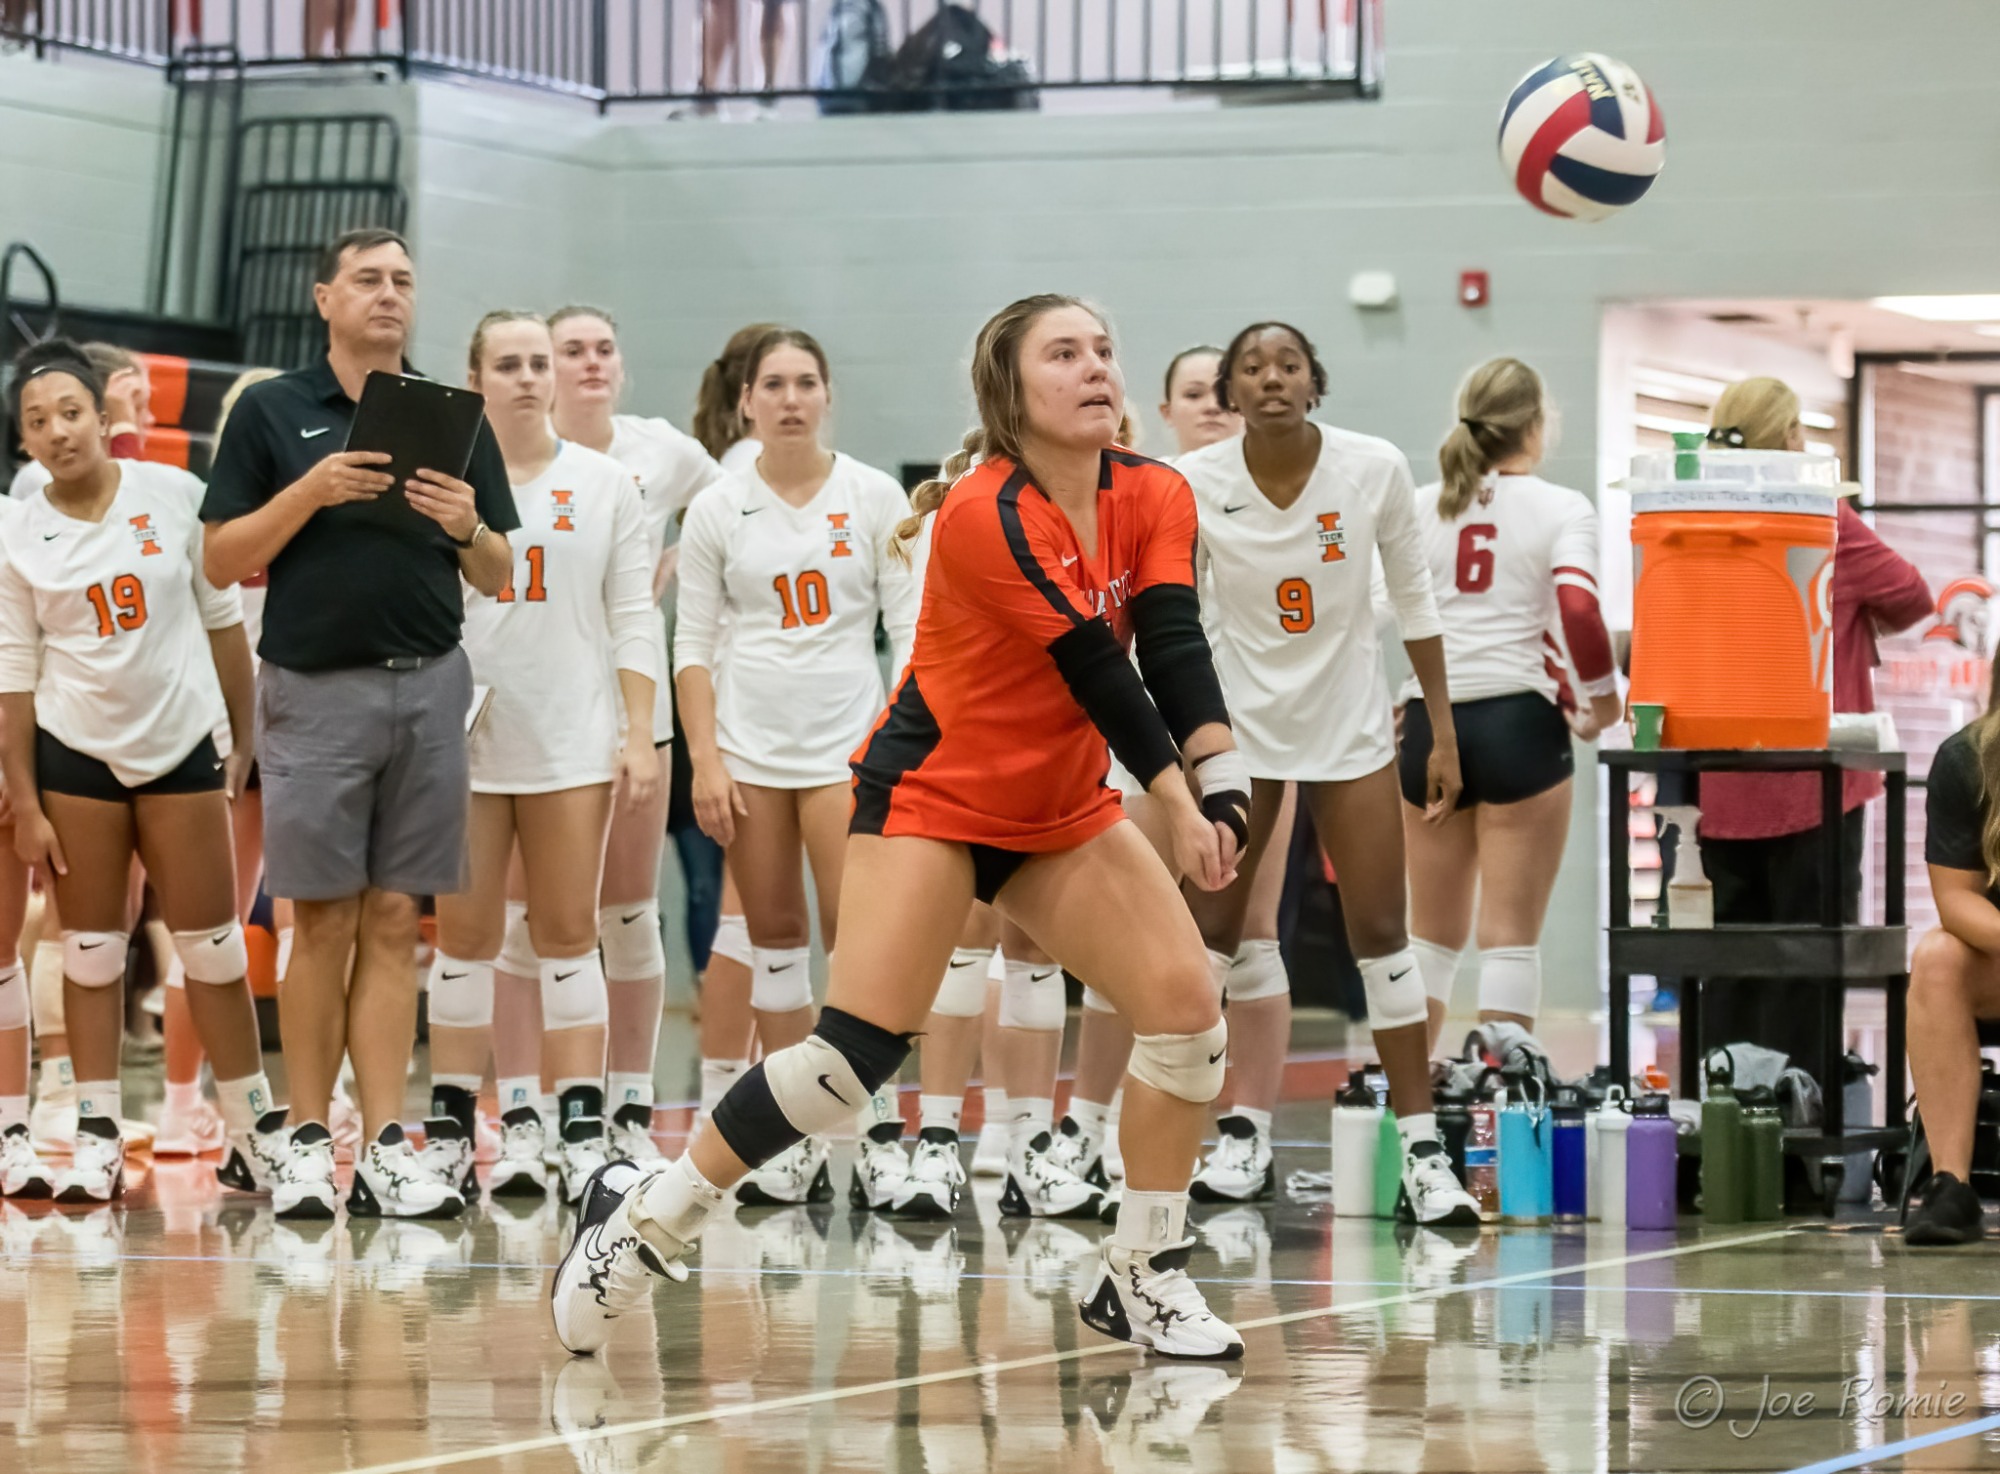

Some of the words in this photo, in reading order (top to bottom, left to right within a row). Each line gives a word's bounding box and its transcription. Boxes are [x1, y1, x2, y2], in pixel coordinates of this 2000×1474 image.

[1456, 524, 1498, 594] 6
[86, 573, 148, 638] 19
[773, 569, 832, 629] 10
[1276, 577, 1315, 634] 9
